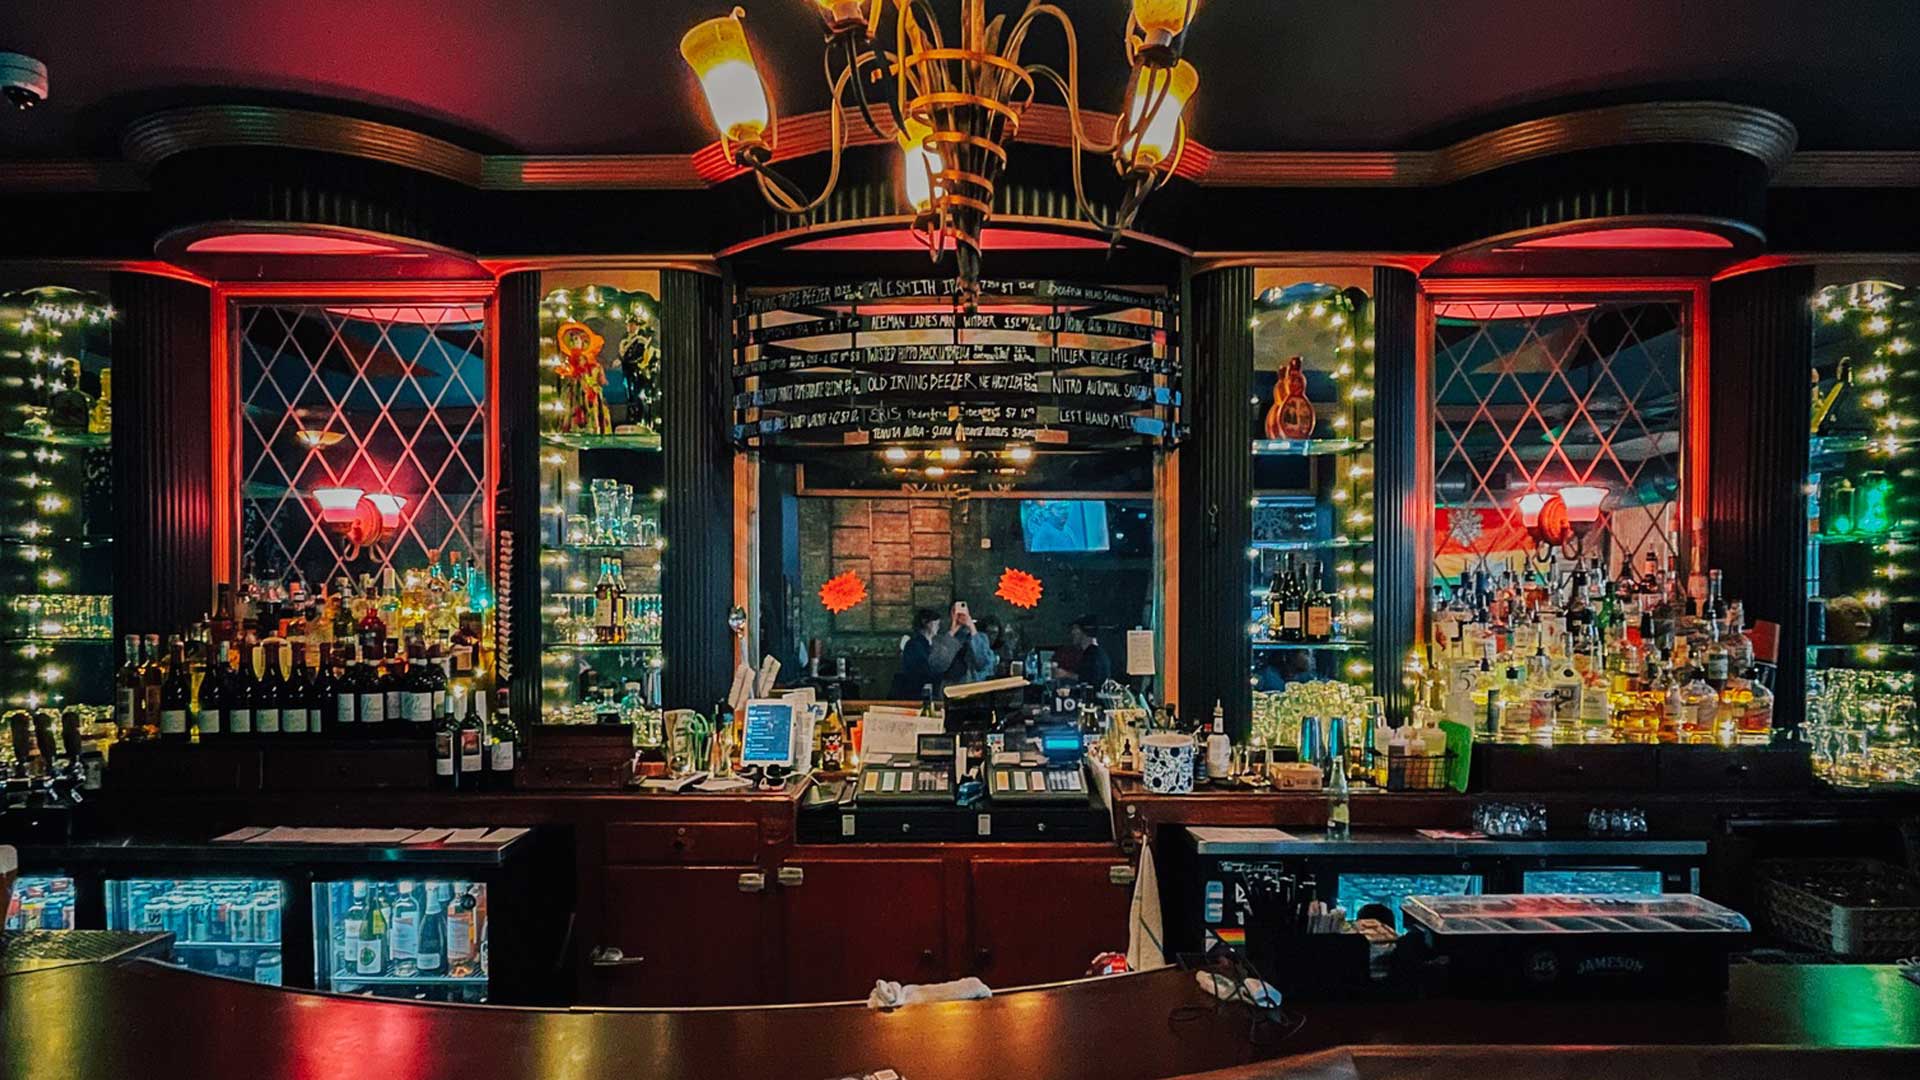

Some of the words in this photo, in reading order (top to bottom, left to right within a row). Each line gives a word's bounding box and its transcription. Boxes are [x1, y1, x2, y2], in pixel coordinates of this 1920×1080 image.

[1051, 347, 1089, 364] MILLER
[1091, 350, 1110, 366] HIGH
[1110, 352, 1129, 369] LIFE
[867, 374, 888, 392] OLD
[889, 372, 928, 392] IRVING
[929, 372, 978, 391] BEEZER
[1052, 378, 1082, 395] NITRO
[1059, 410, 1081, 423] LEFT
[1085, 410, 1110, 426] HAND
